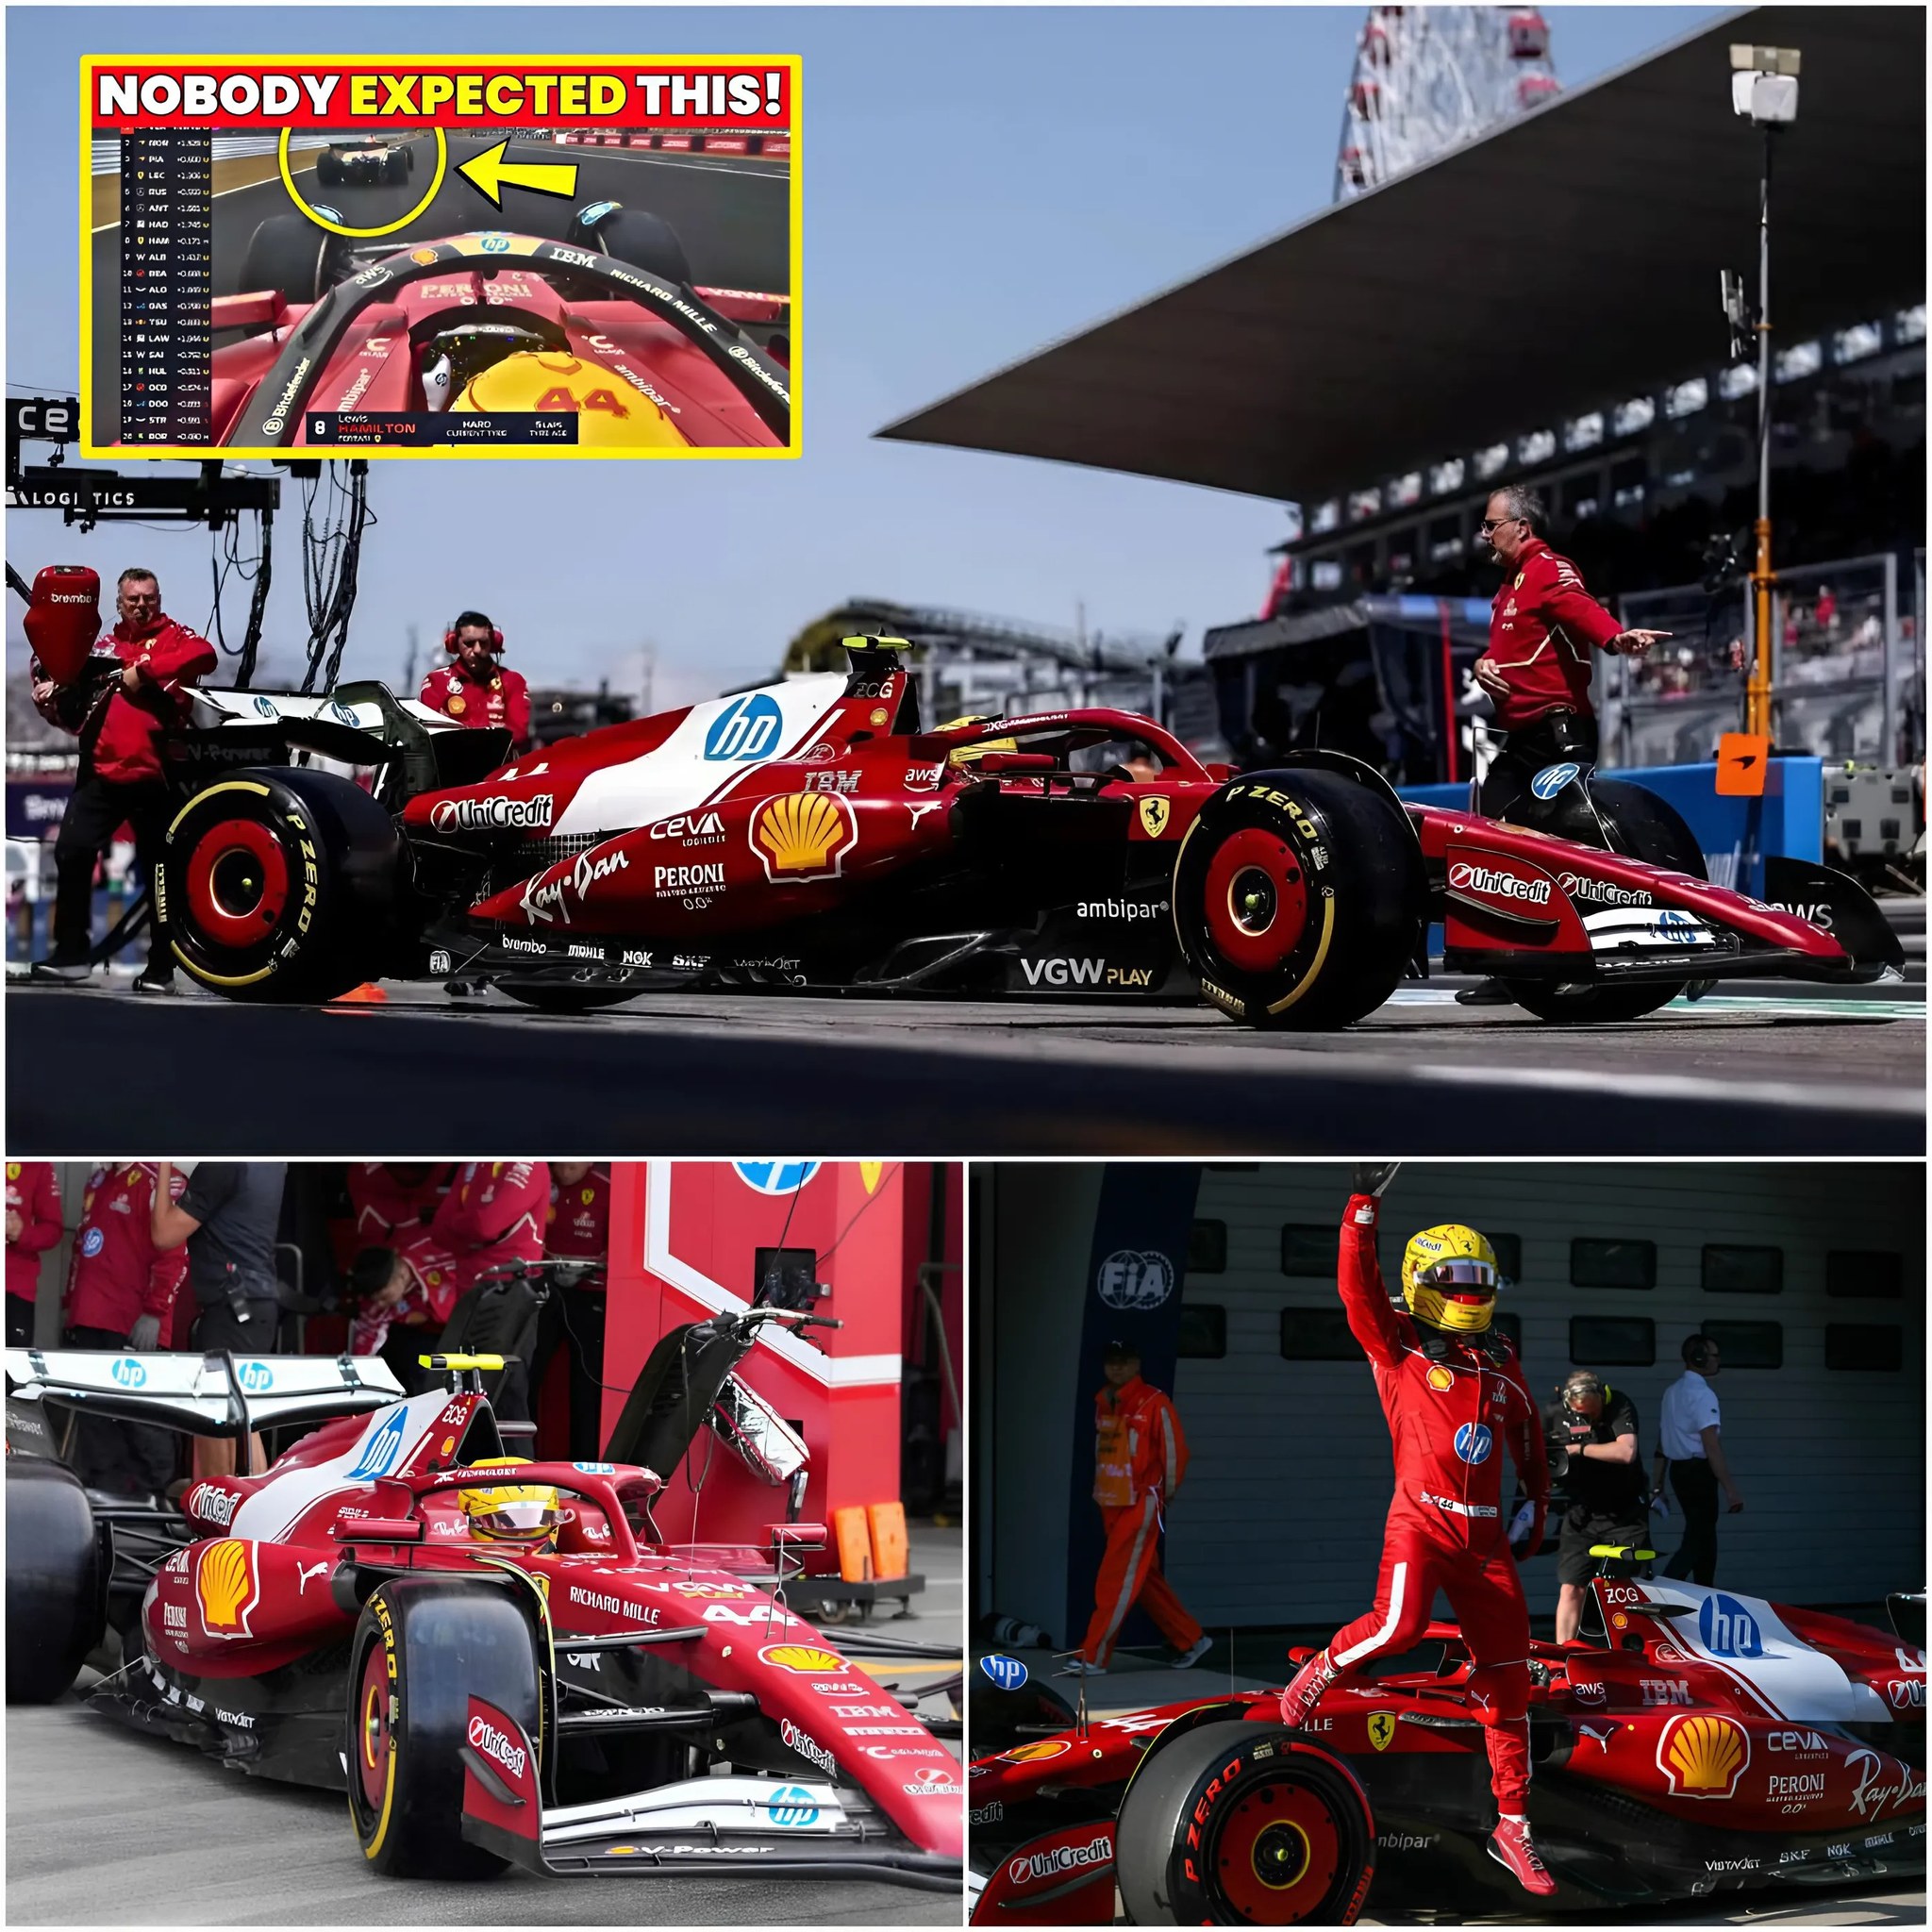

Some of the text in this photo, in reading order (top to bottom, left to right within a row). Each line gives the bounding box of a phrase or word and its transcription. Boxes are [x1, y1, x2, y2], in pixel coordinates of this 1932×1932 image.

[148, 286, 168, 294] ALO
[148, 334, 170, 342] LAW
[314, 420, 326, 435] 8
[338, 424, 416, 434] HAMILTON
[33, 491, 135, 506] LOGITICS
[705, 694, 783, 760] hp
[804, 770, 863, 793] IBM
[1532, 762, 1580, 800] hp
[457, 793, 554, 829] UniCredit
[1248, 785, 1319, 840] ZERO
[299, 839, 320, 934] ZERO
[654, 862, 725, 889] PERONI
[1472, 865, 1551, 905] UniCredit
[1021, 958, 1153, 986] VGW PLAY
[112, 1358, 146, 1388] hp
[240, 1362, 274, 1390] hp
[345, 1406, 408, 1481] hp
[1455, 1423, 1492, 1465] hp
[570, 1586, 661, 1625] RICHARD MILLE
[1604, 1587, 1640, 1604] ZCG
[702, 1605, 800, 1626] 44
[1699, 1594, 1765, 1659] hp
[375, 1598, 397, 1679] ZERO
[983, 1656, 1025, 1690] hp
[1575, 1682, 1605, 1696] aws
[1640, 1679, 1694, 1706] IBM
[1769, 1774, 1825, 1795] PERONI
[769, 1787, 820, 1826] hp
[1184, 1757, 1241, 1883] P ZERO
[641, 1845, 775, 1855] V-Power
[1030, 1837, 1113, 1878] UniCredit
